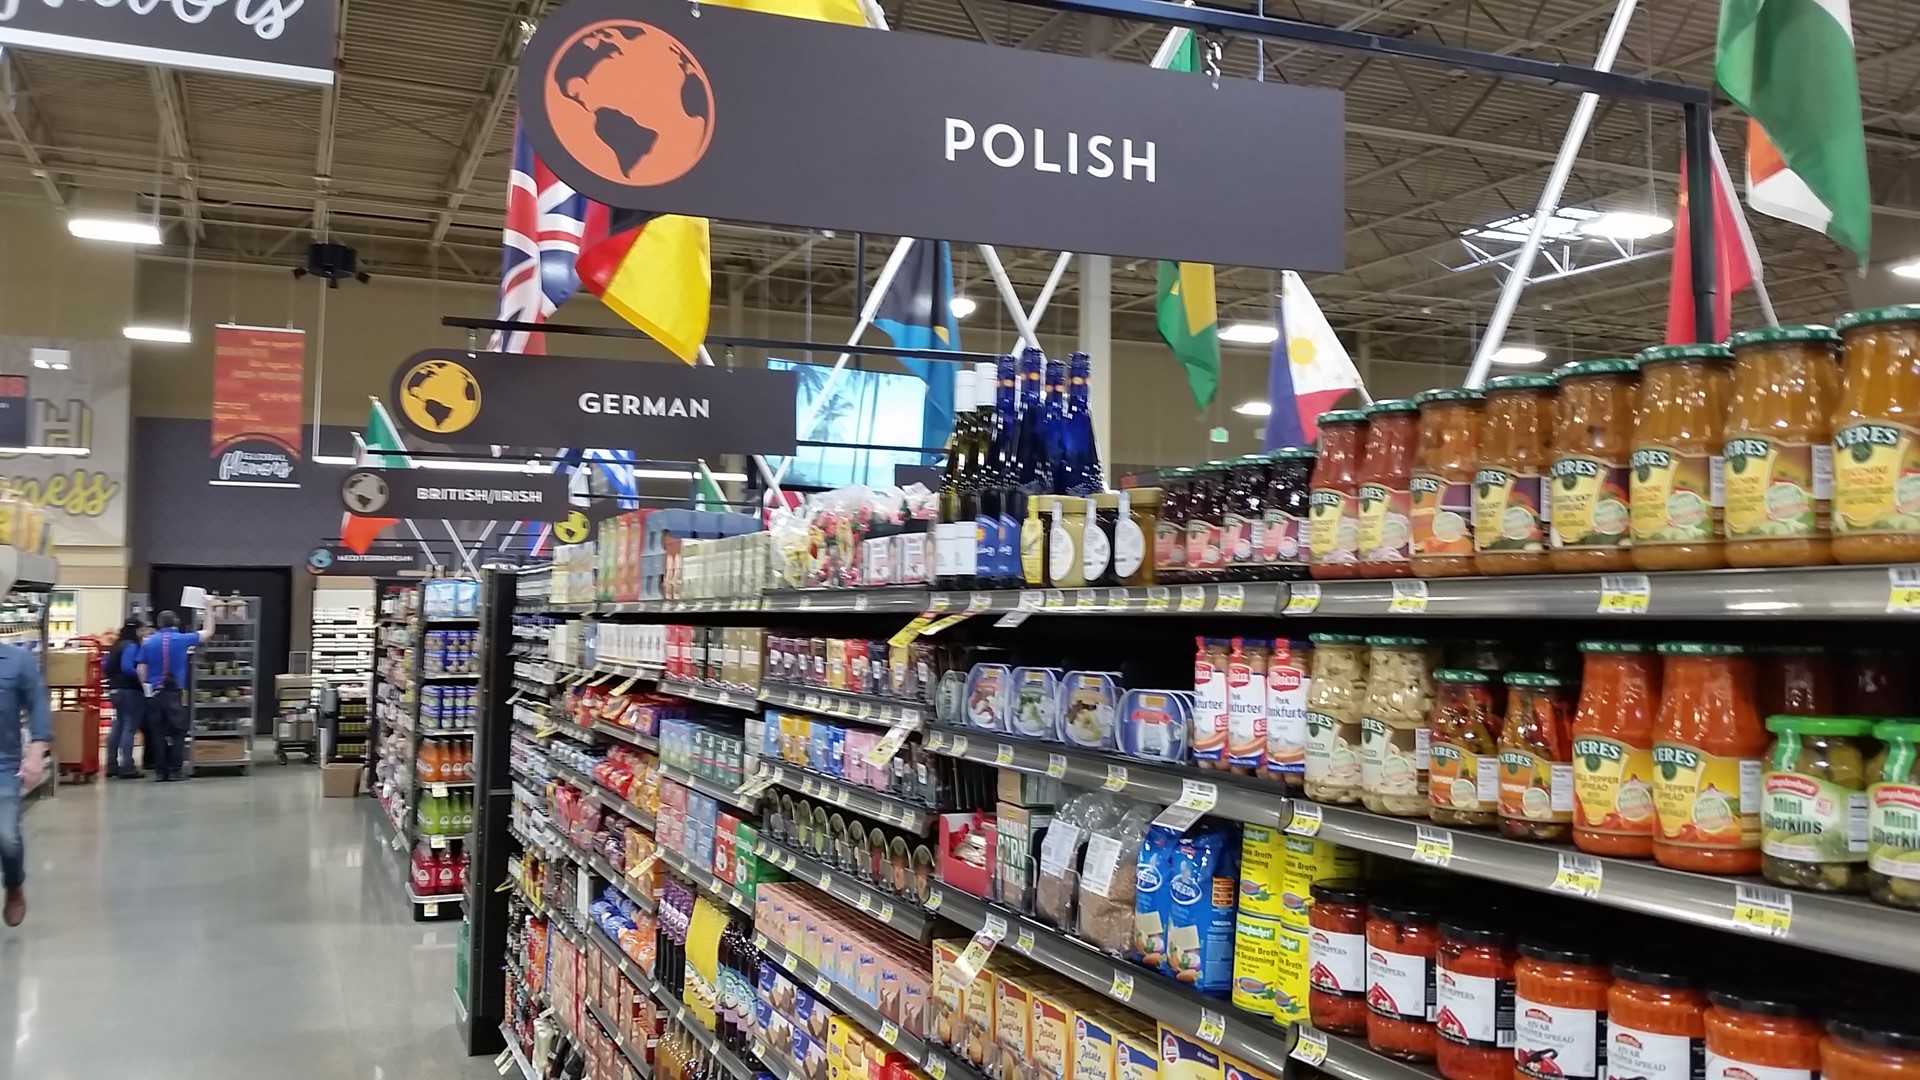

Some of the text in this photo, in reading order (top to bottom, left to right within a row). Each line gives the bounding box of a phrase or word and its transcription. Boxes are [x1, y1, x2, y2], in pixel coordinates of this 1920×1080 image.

[945, 117, 1155, 183] POLISH
[578, 392, 710, 419] GERMAN
[1836, 426, 1898, 448] VERES
[1631, 449, 1669, 467] ERES
[1724, 439, 1767, 459] ERES
[416, 487, 543, 504] BRITISH/IRISH
[1305, 712, 1334, 728] ERES
[1361, 718, 1385, 734] ERES
[1430, 746, 1460, 760] VERES
[1500, 753, 1532, 766] VERES
[1574, 740, 1621, 760] VERES
[1652, 747, 1698, 768] VERES
[1774, 797, 1803, 815] Mini
[1884, 809, 1918, 830] Mini
[1872, 826, 1920, 849] herki
[1257, 947, 1279, 957] Broth
